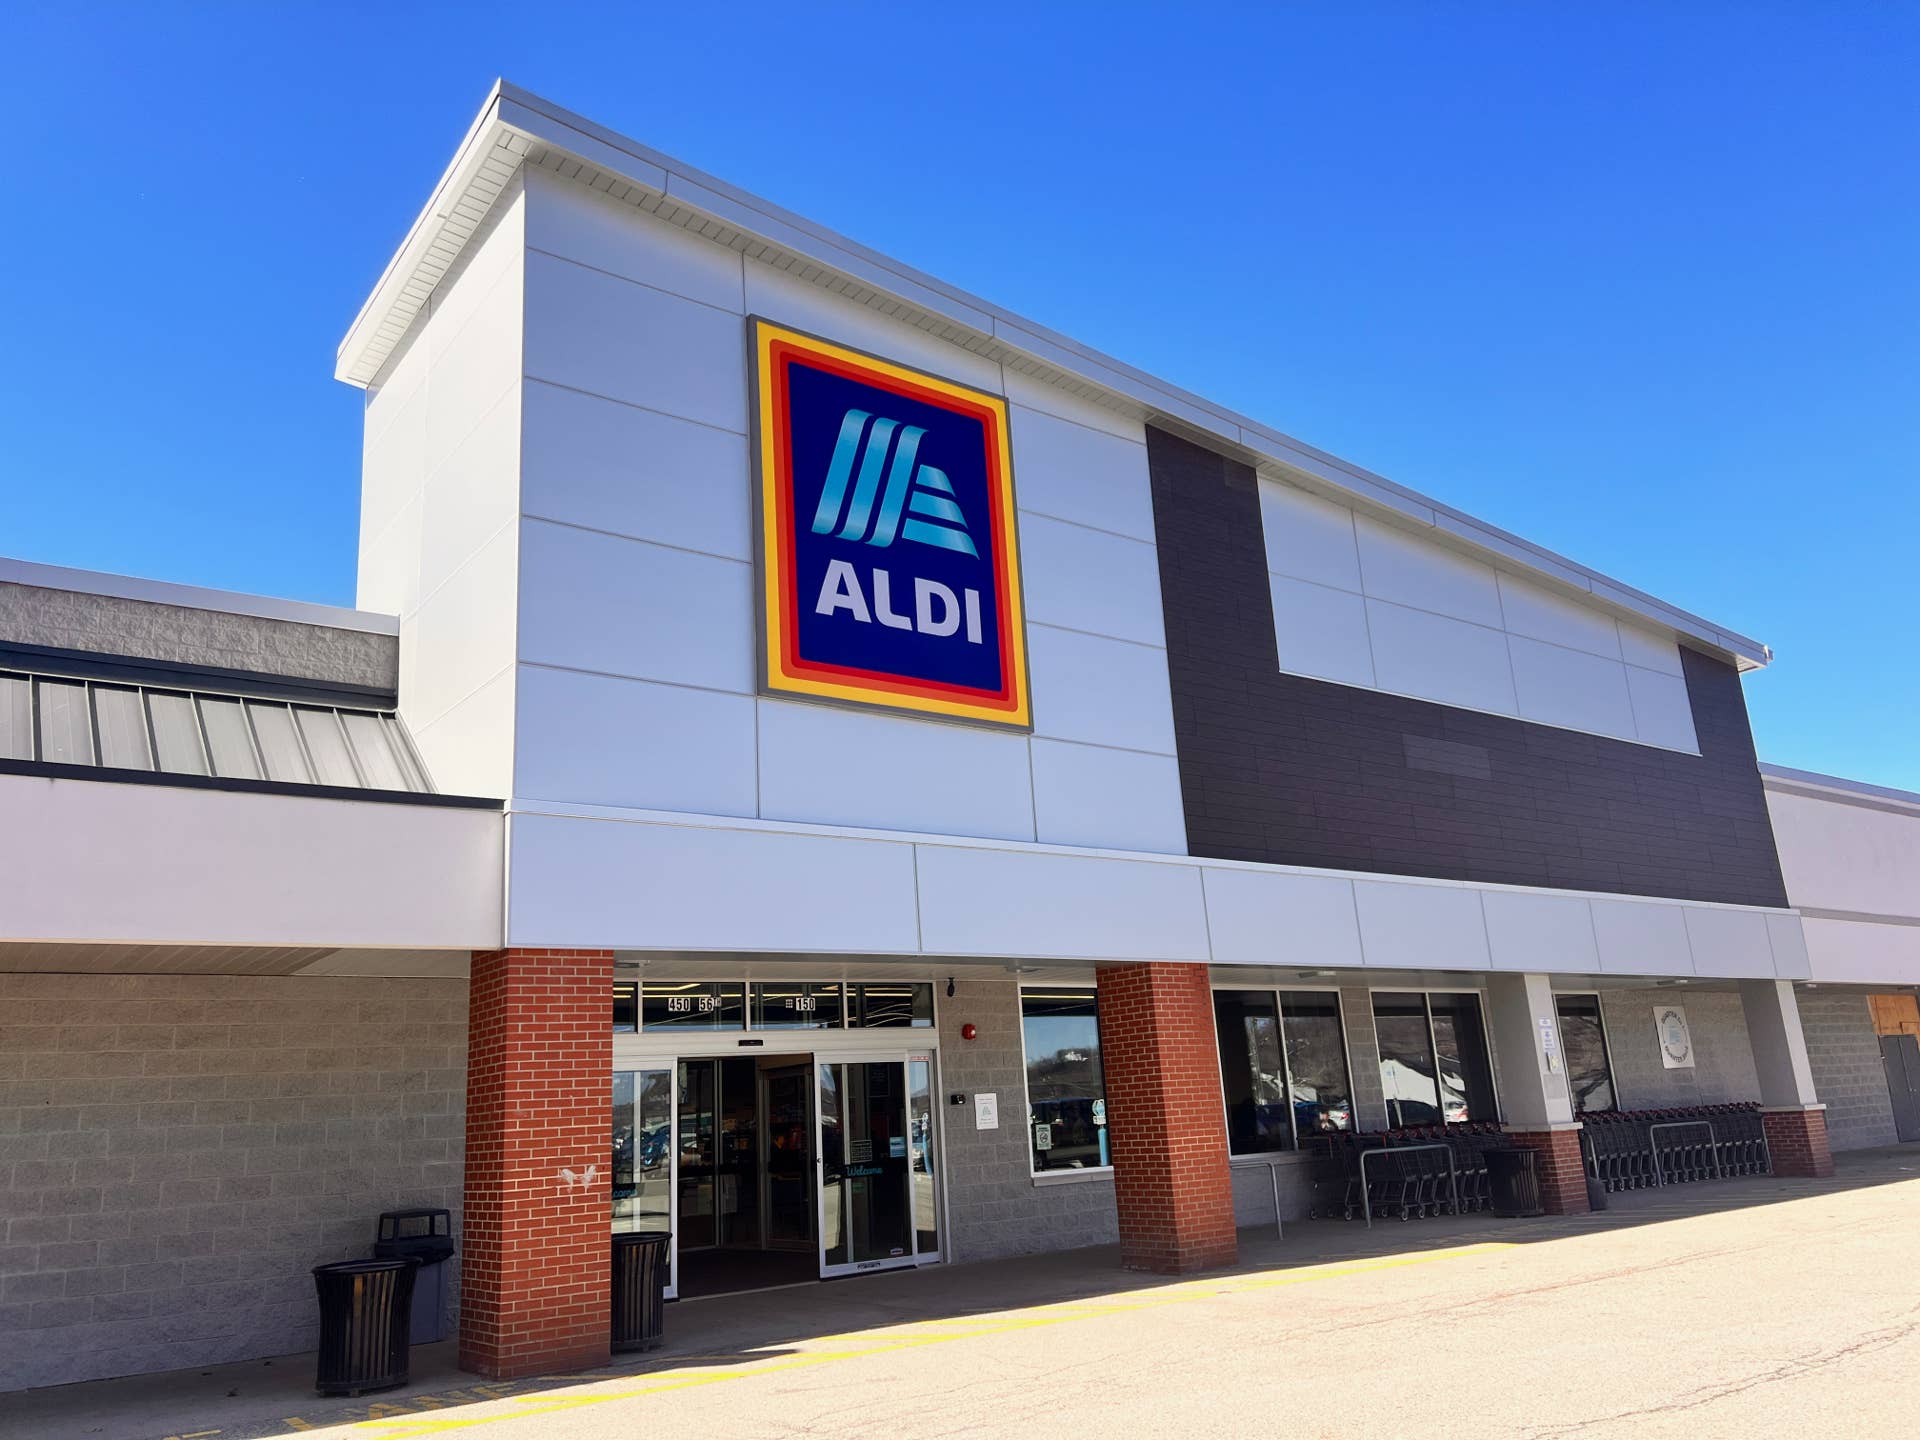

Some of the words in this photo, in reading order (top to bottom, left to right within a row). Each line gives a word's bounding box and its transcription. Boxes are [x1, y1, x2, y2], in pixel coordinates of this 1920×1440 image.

[815, 558, 983, 645] ALDI
[669, 998, 690, 1011] 450
[846, 1166, 883, 1177] Welcome
